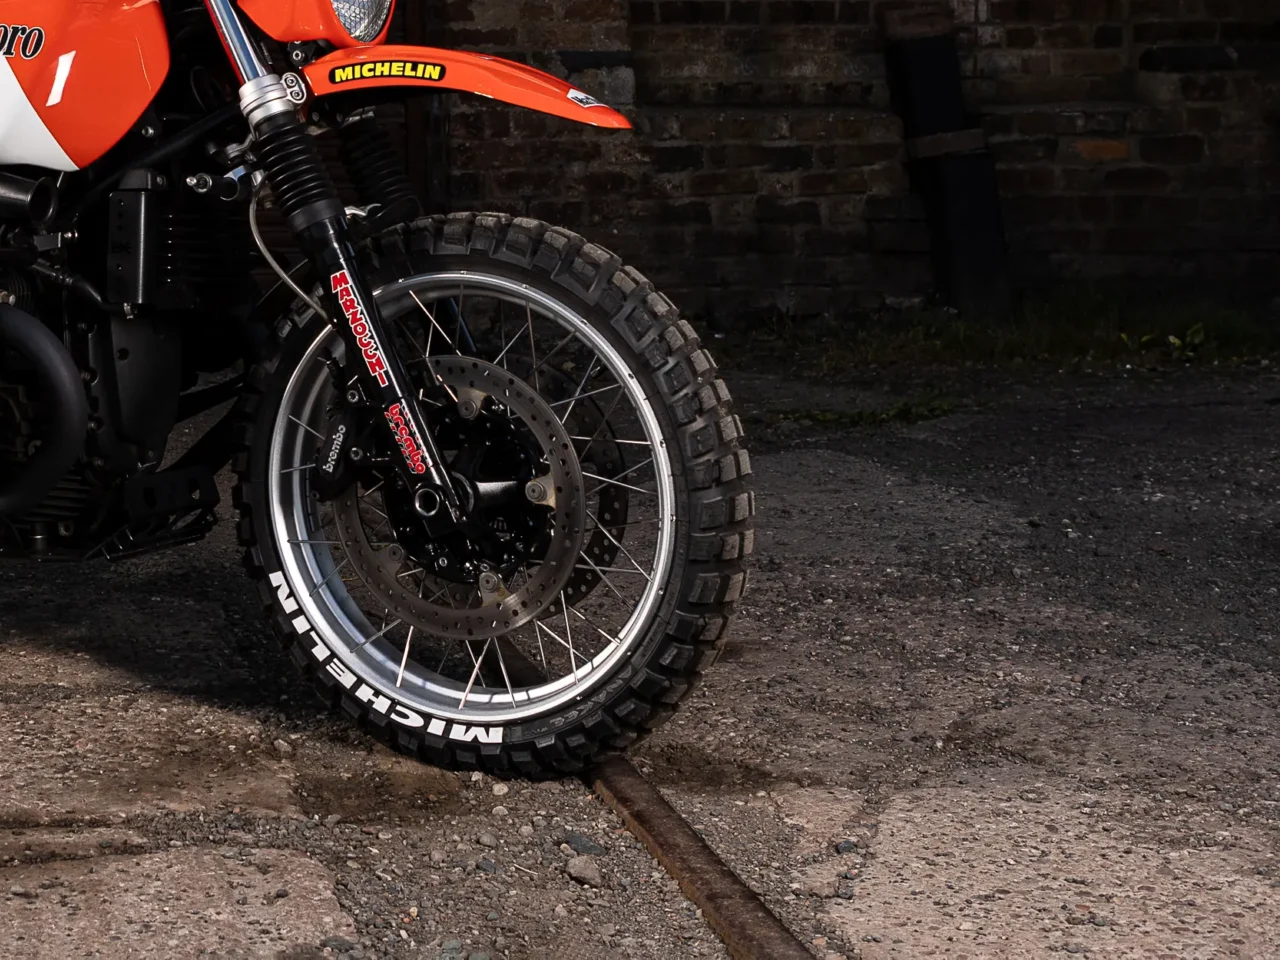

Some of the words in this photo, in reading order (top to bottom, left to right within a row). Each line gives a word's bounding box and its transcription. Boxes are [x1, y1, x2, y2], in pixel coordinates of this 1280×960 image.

[333, 61, 442, 83] MICHELIN
[322, 424, 347, 473] brembo
[388, 402, 426, 475] brembo
[268, 570, 505, 744] MICHELIN
